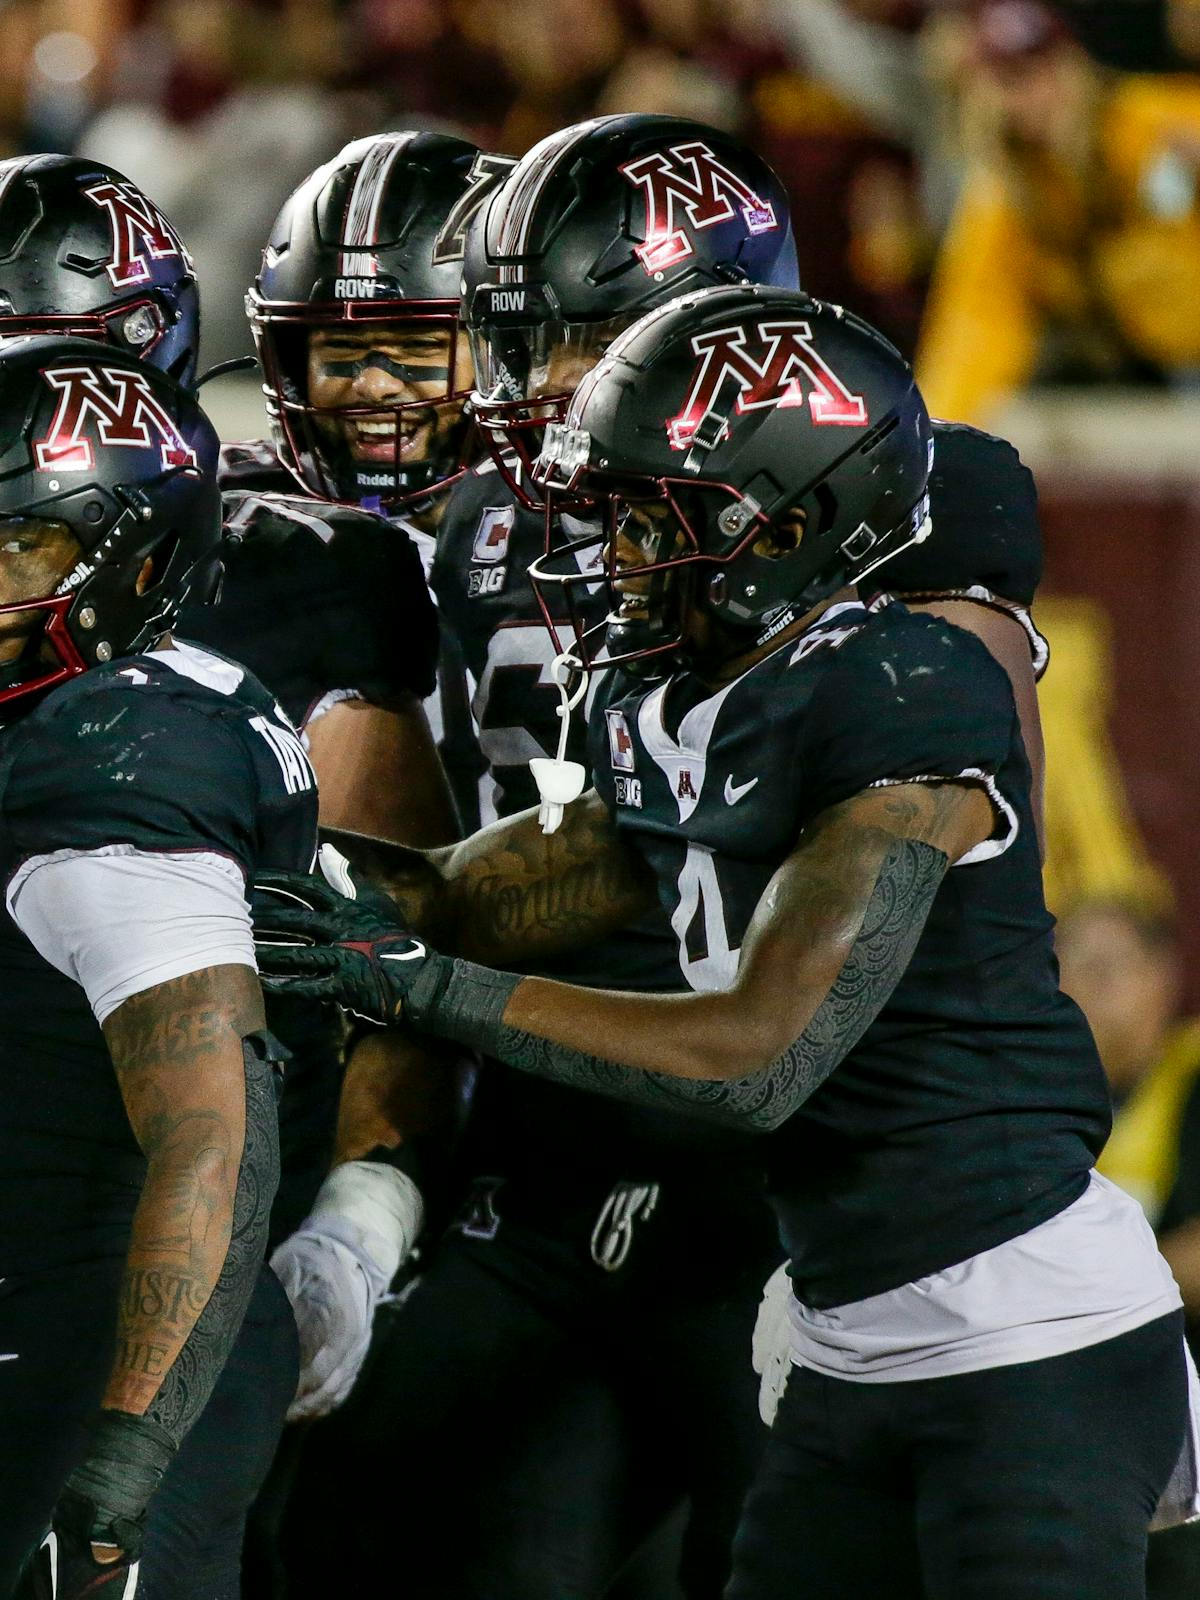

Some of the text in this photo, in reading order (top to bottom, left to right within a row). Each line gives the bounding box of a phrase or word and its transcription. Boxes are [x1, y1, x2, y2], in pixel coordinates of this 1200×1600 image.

[618, 141, 779, 277] M
[335, 279, 377, 299] ROW
[491, 291, 525, 312] ROW
[32, 365, 202, 476] M
[667, 321, 870, 450] M
